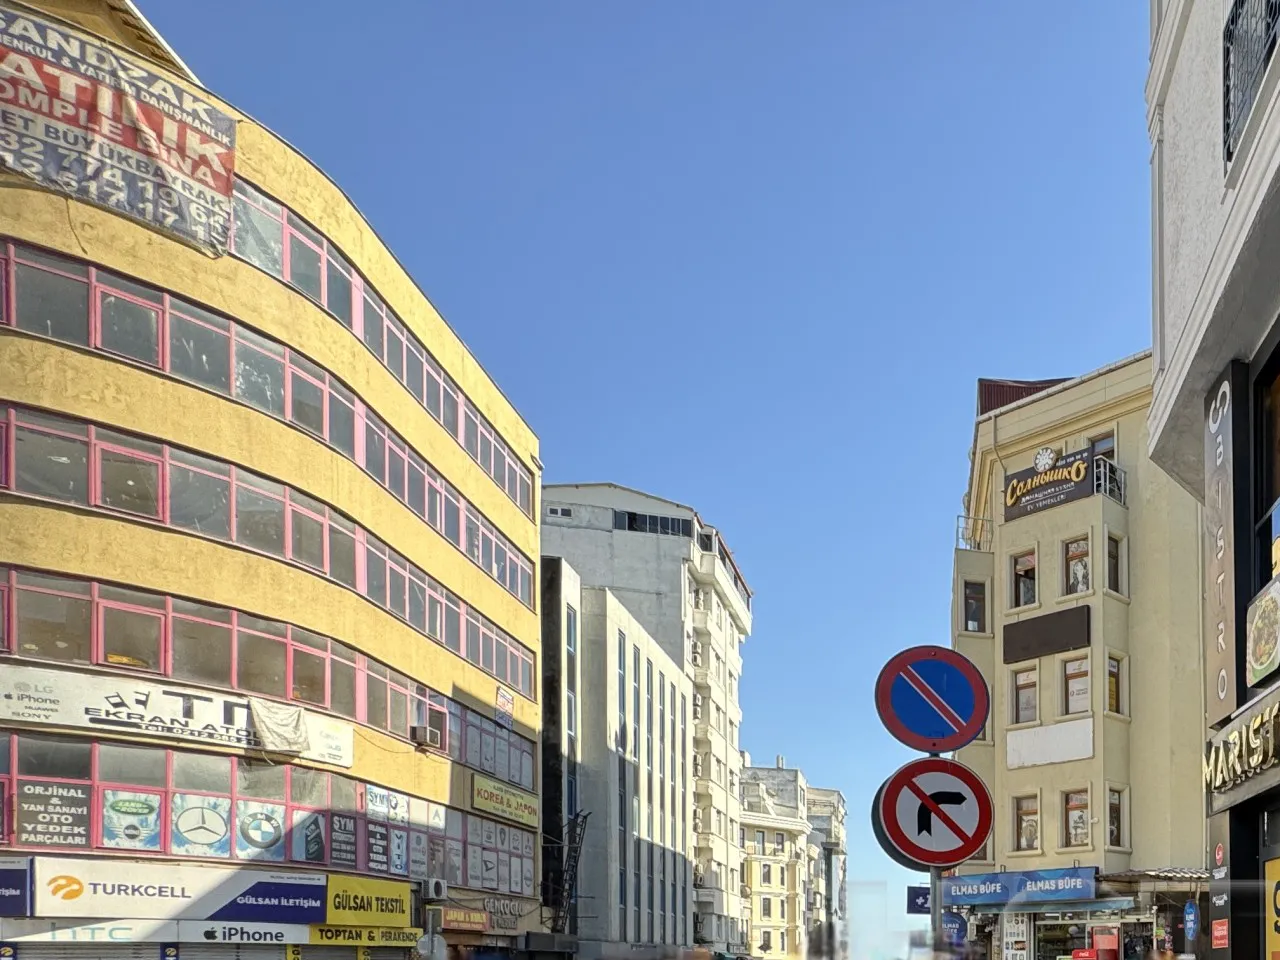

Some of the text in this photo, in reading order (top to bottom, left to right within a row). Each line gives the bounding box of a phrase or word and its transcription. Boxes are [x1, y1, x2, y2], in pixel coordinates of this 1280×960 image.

[0, 12, 213, 127] ANDZAK
[34, 684, 54, 694] LG
[17, 693, 60, 704] iPhone
[84, 707, 190, 729] EKRAN
[23, 785, 87, 798] ORJİNAL
[476, 788, 505, 807] KOREA
[49, 797, 62, 805] &
[21, 803, 88, 815] YAN SANAYİ
[38, 813, 73, 824] OTO
[333, 815, 354, 831] SYM
[22, 823, 87, 835] YEDEK
[21, 833, 87, 845] PARÇALARI
[88, 882, 192, 899] TURKCELL
[951, 884, 978, 896] ELMAS
[1026, 876, 1083, 892] ELMAS BÜFE
[236, 894, 321, 908] GÜLSAN İLETİŞİM
[334, 890, 406, 915] GÜLSAN TEKSTİL
[222, 926, 285, 942] iPhone
[318, 928, 419, 942] TOPTAN & PERAKENDE
